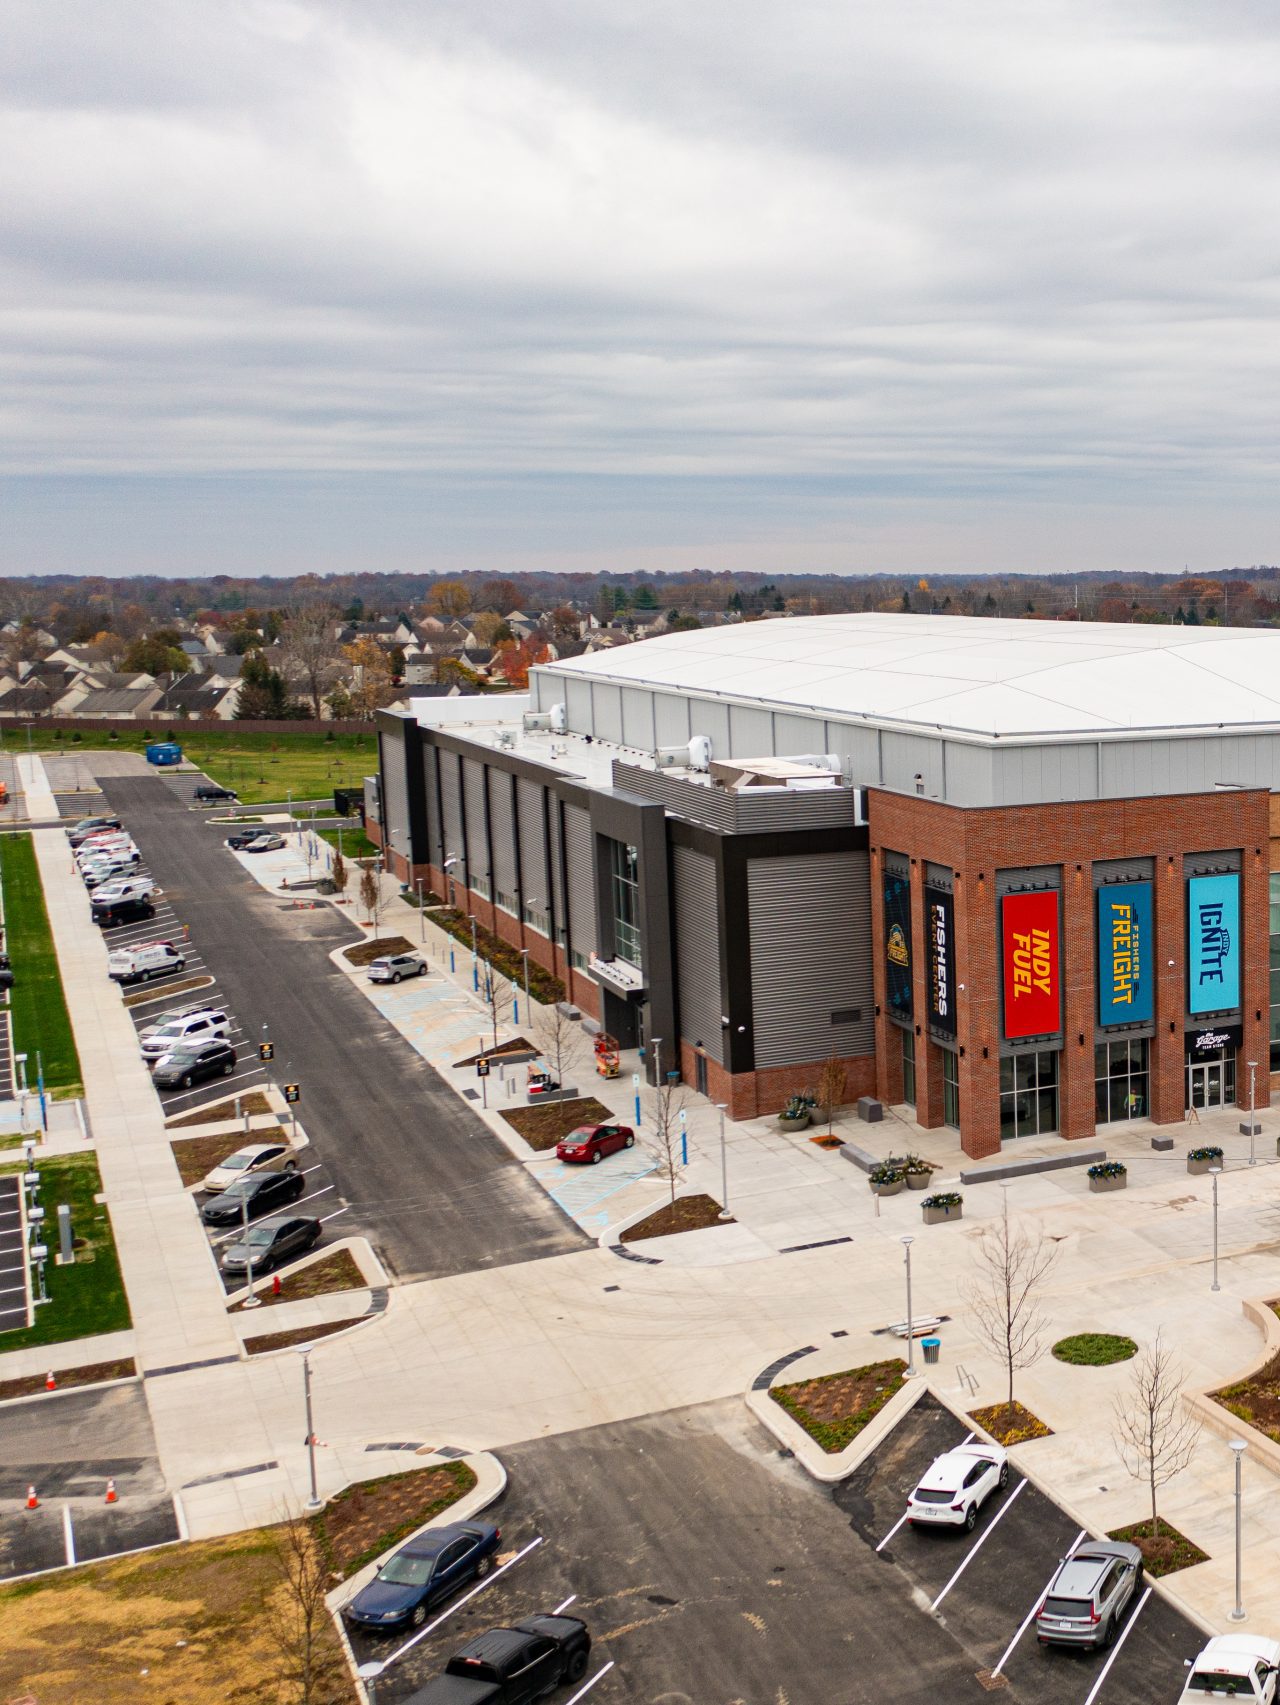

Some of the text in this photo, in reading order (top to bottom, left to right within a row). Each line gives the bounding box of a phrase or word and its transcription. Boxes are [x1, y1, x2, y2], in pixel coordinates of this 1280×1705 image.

[936, 904, 948, 1017] FISHERS
[1012, 932, 1032, 998] FUEL
[1031, 928, 1051, 997] INDY
[1111, 903, 1132, 1005] FREIGHT
[1132, 925, 1140, 980] FISHERS
[1199, 902, 1224, 986] IGNITE
